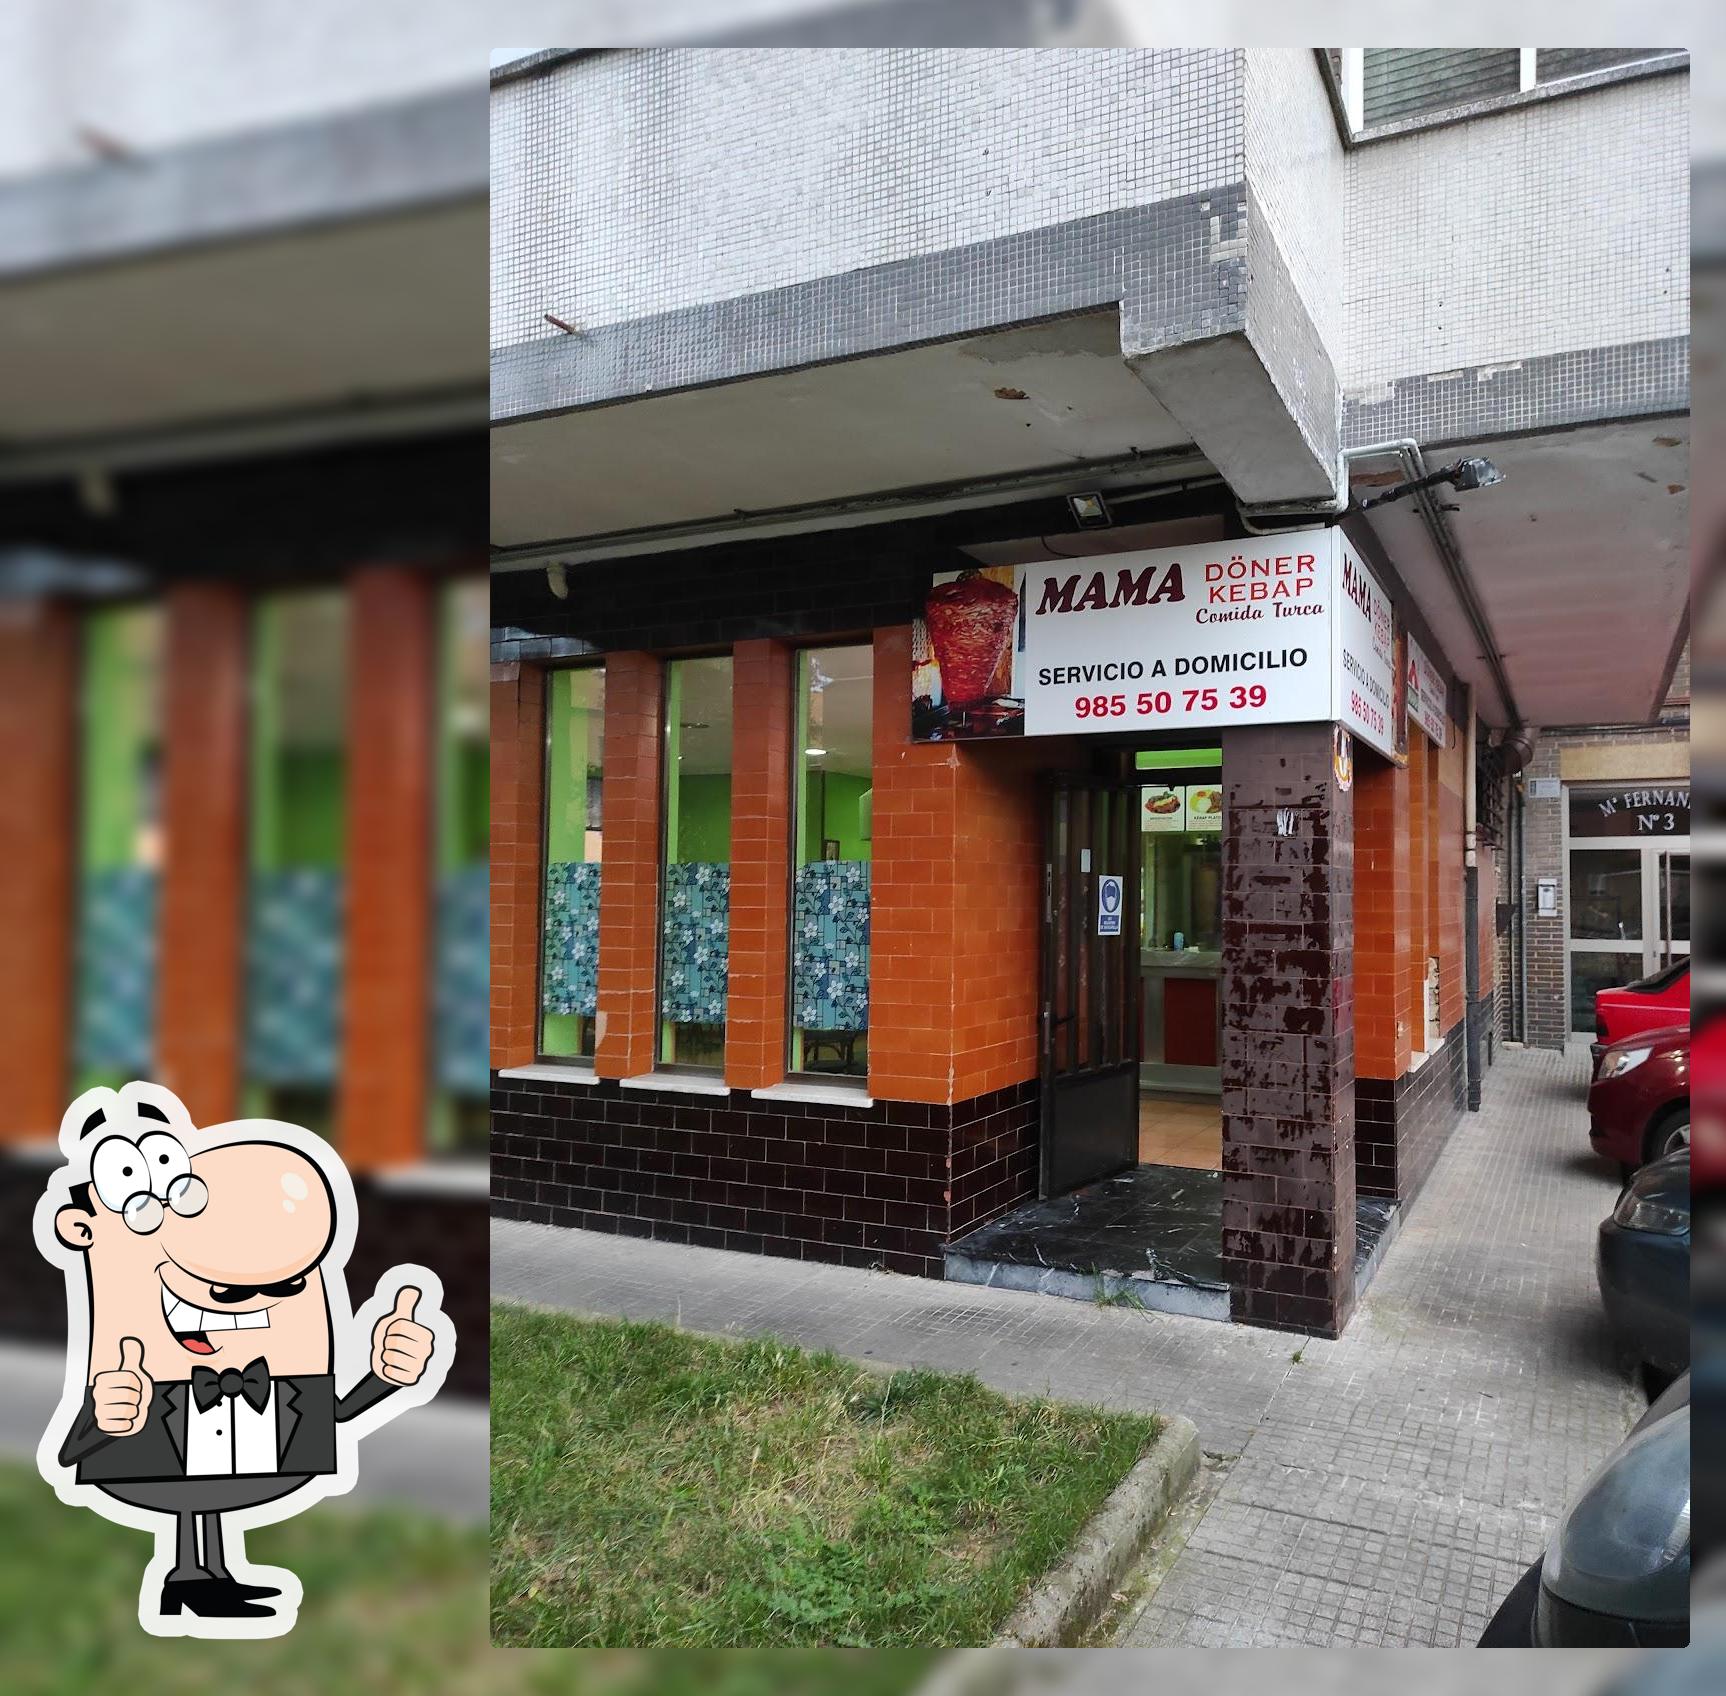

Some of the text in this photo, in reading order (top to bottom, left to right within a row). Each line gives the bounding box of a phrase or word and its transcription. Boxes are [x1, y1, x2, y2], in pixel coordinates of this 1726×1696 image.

[1205, 554, 1315, 582] DÖNER
[1035, 563, 1186, 615] MAMA
[1209, 577, 1313, 604] KEBAP
[1342, 552, 1372, 623] MAMA
[1196, 602, 1325, 624] Comida Turca
[1039, 648, 1307, 686] SERVICIO A DOMICILIO
[1343, 648, 1366, 686] SERVICIO
[1075, 685, 1267, 718] 985 50 75 39
[1624, 790, 1690, 809] FERNAN
[1663, 812, 1675, 831] 3
